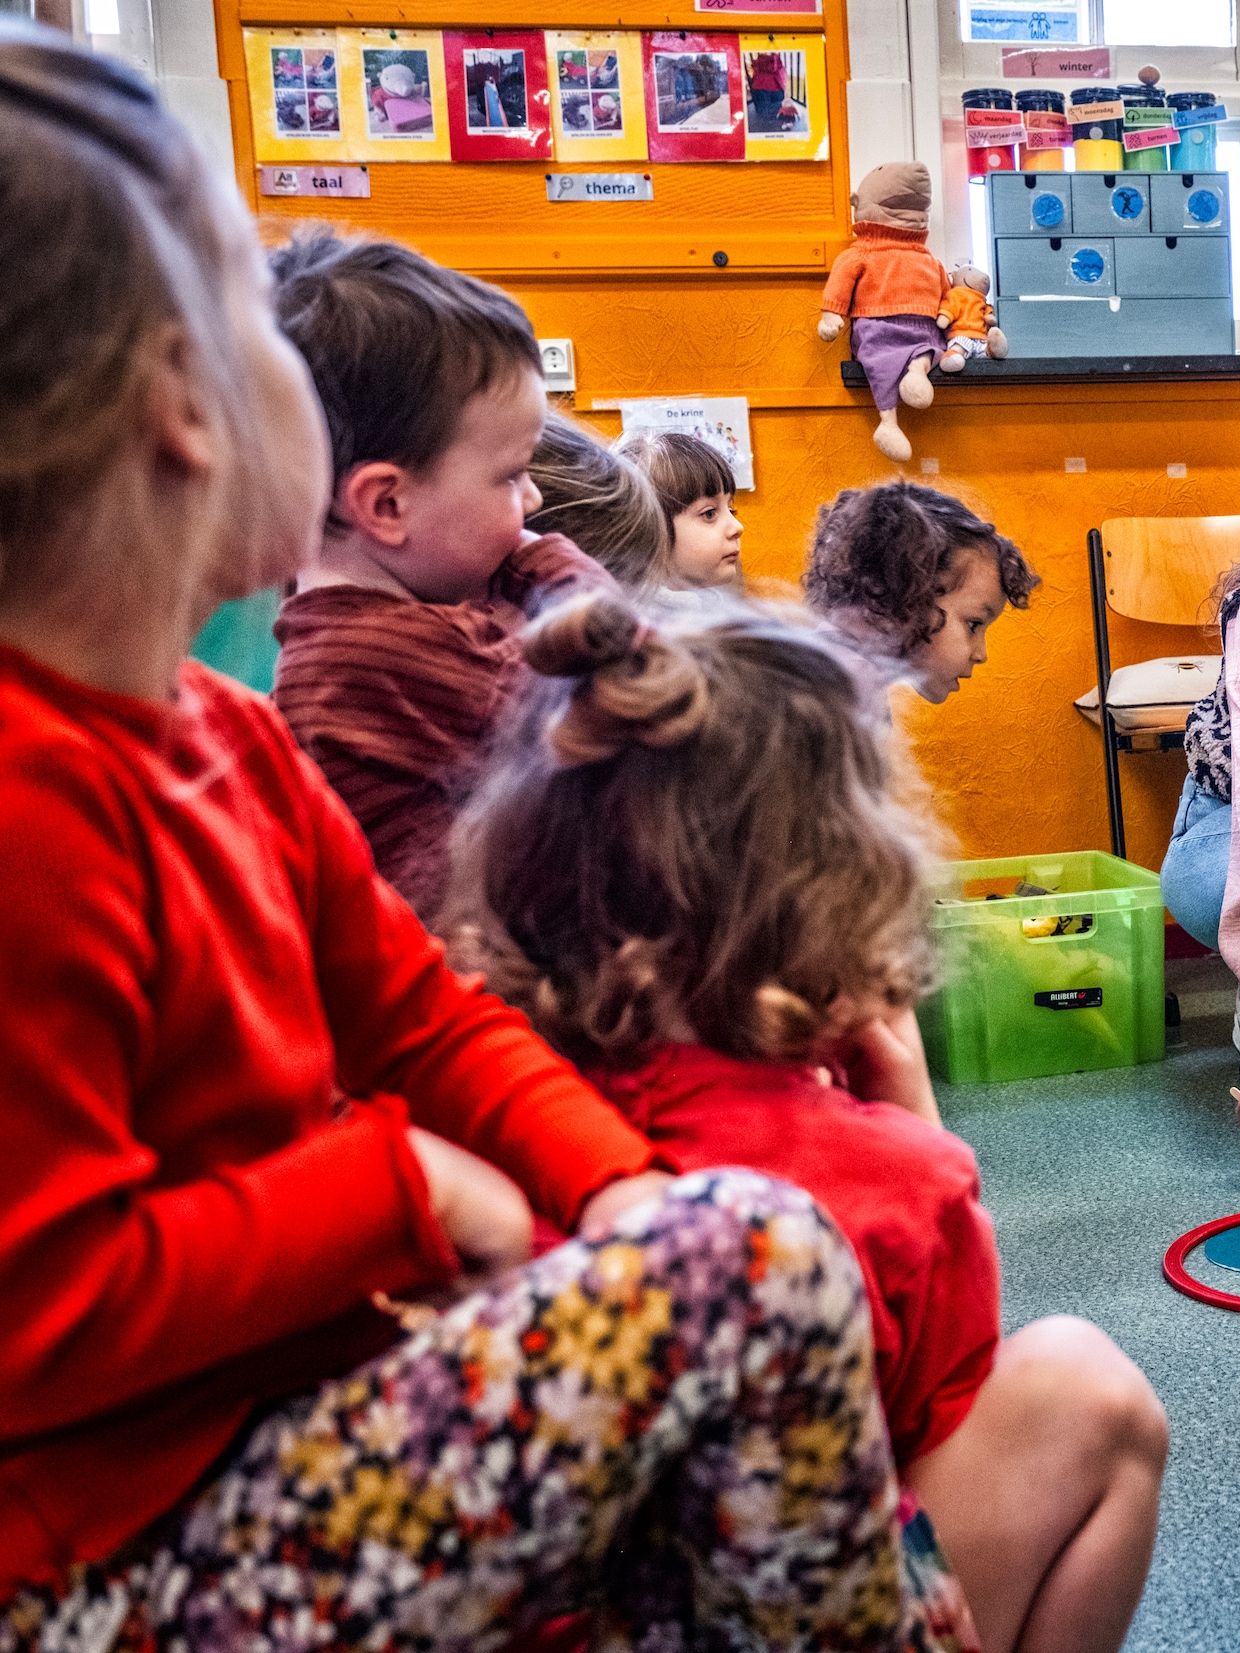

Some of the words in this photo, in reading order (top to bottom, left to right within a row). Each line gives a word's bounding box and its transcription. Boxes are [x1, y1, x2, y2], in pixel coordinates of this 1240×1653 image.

[1059, 61, 1093, 71] winter
[1084, 106, 1114, 115] woensdag
[984, 115, 1012, 124] maandag
[989, 131, 1022, 140] verjaardag
[312, 175, 342, 188] taal
[585, 181, 636, 194] thema
[667, 410, 679, 418] De
[681, 409, 704, 419] kring
